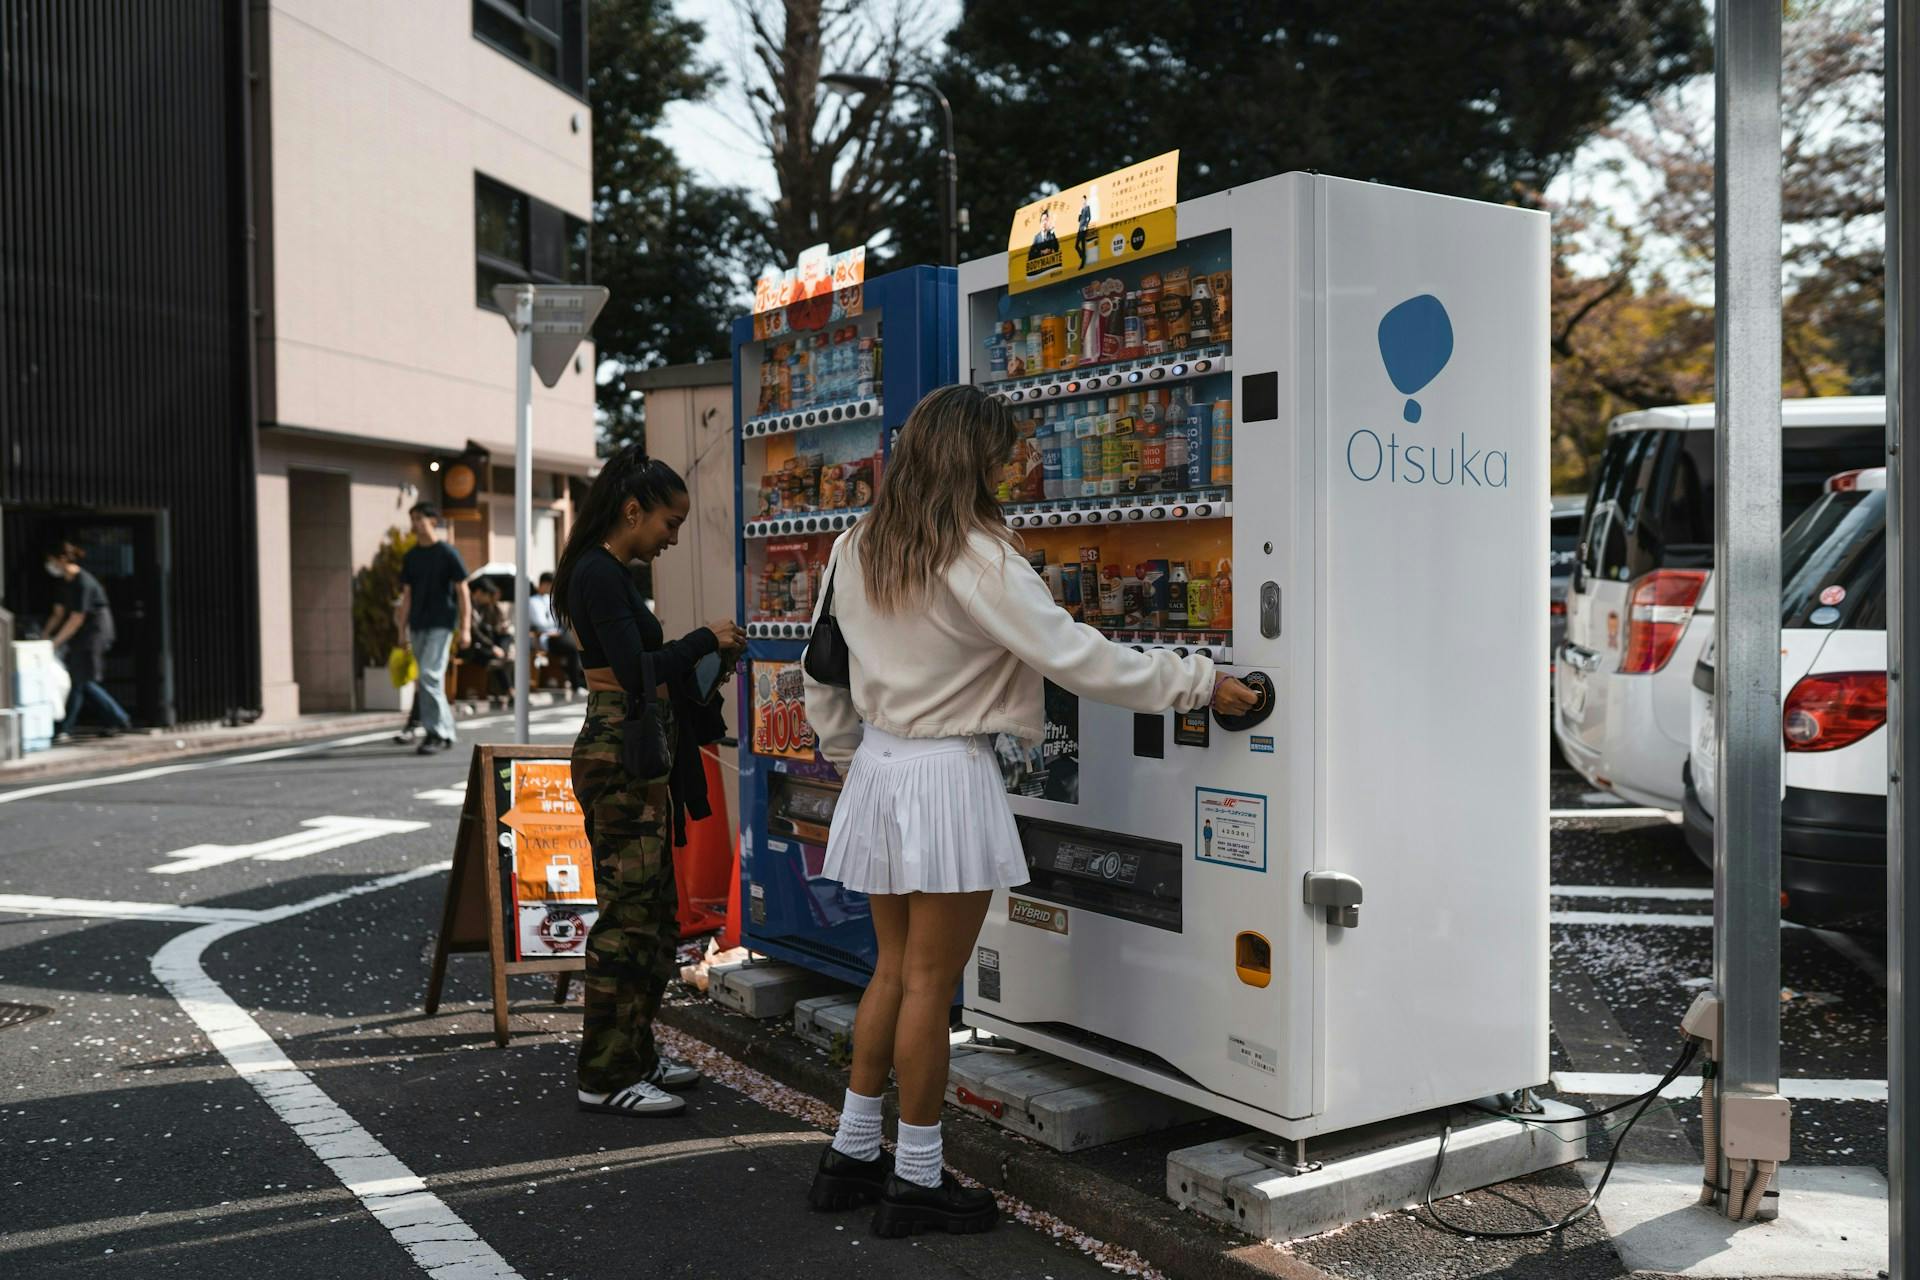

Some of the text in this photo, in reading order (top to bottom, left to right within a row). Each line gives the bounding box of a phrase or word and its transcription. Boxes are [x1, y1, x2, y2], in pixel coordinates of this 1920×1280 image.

[1189, 416, 1200, 482] POCARI
[1347, 429, 1508, 488] Otsuka
[568, 838, 589, 850] OU
[543, 911, 582, 929] COFFEE
[1011, 903, 1051, 922] HYBRID
